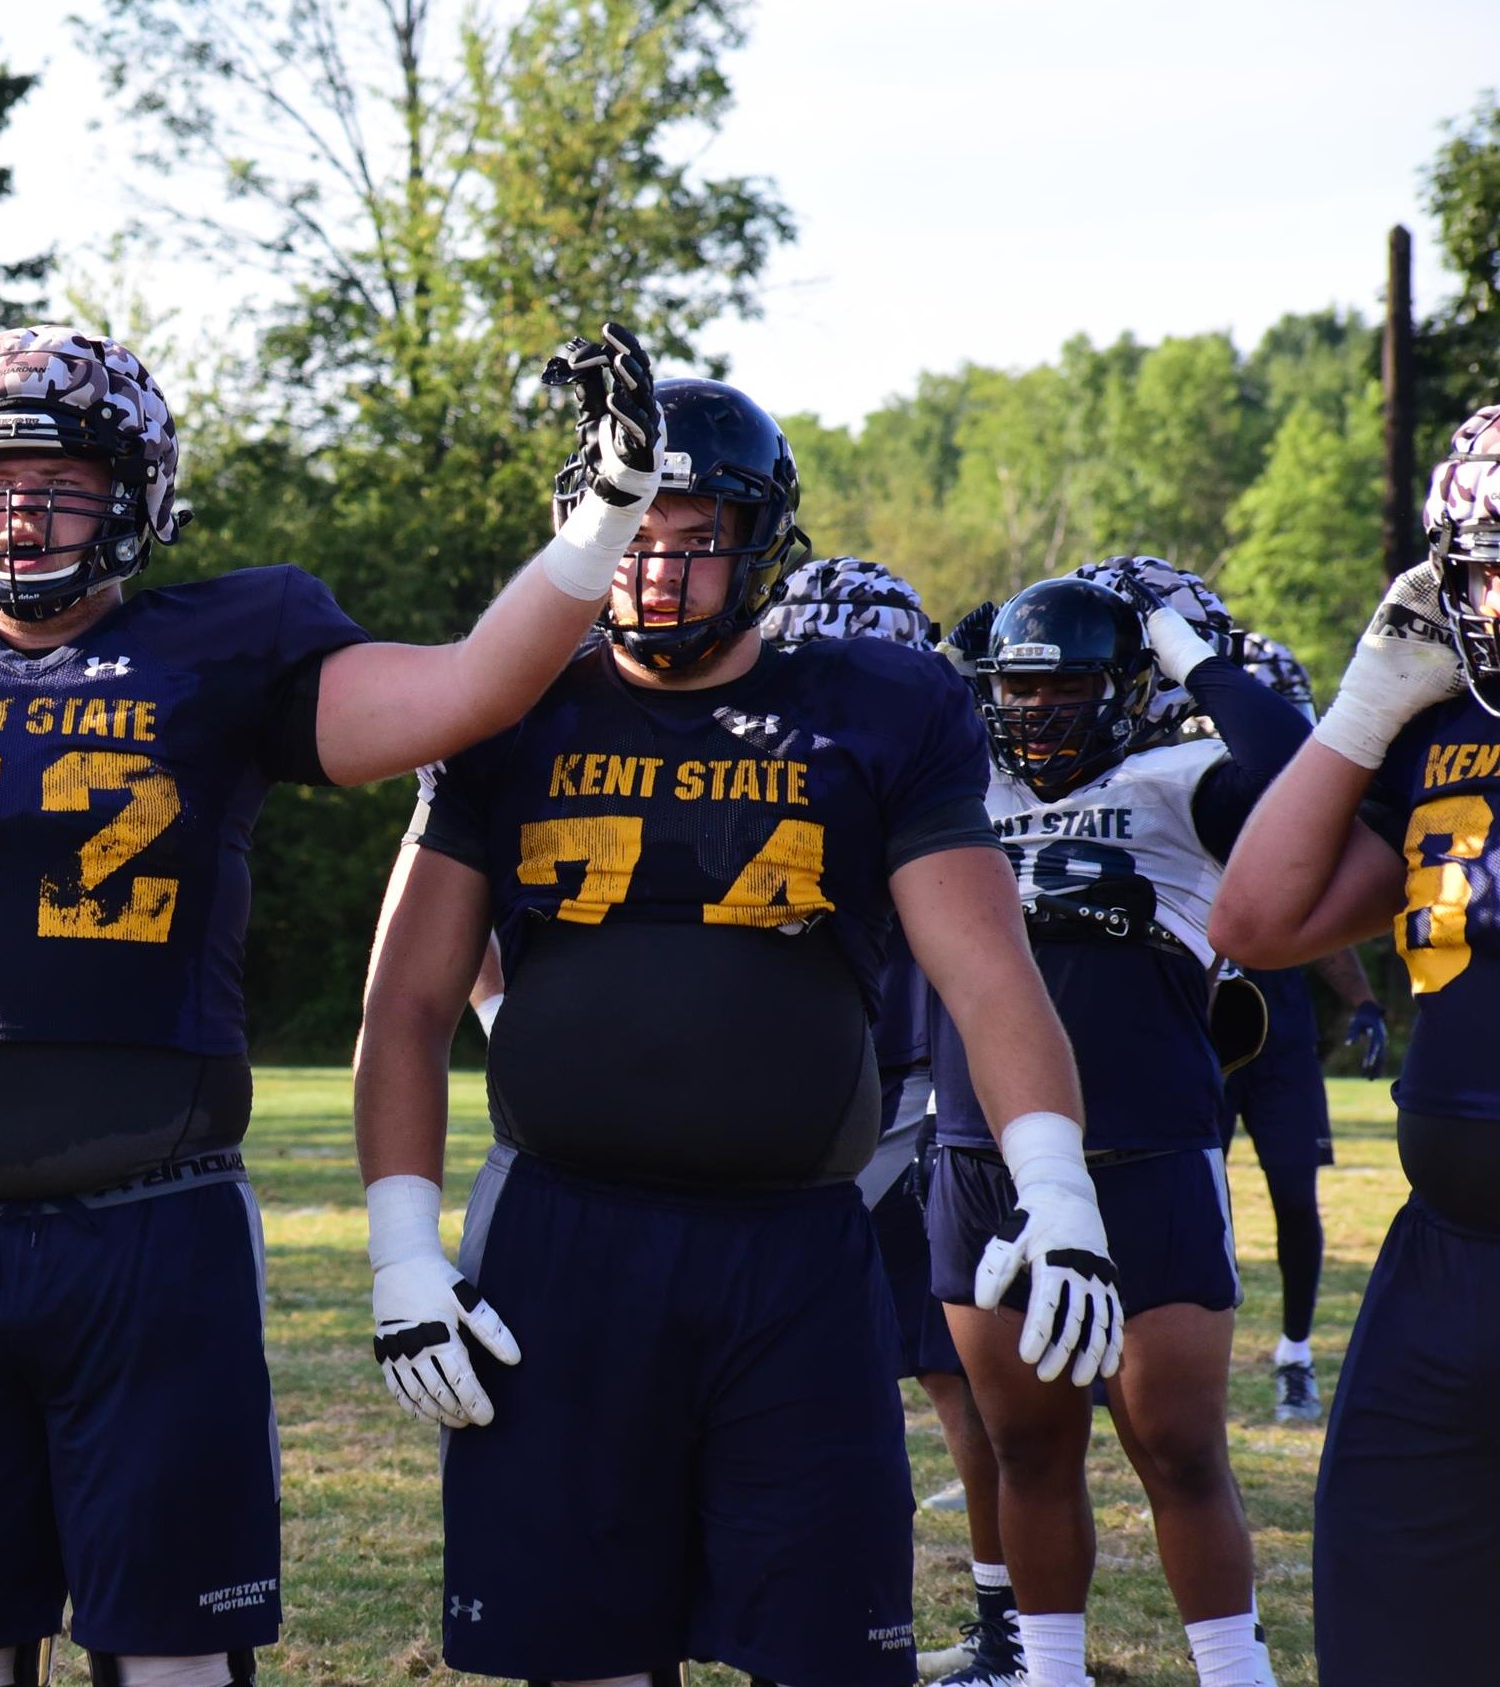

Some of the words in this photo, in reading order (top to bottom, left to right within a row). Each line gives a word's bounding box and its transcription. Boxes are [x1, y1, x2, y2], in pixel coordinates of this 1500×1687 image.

[26, 697, 156, 742] STATE
[550, 753, 664, 798] KENT
[674, 759, 809, 806] STATE
[1424, 743, 1500, 790] KEN
[1041, 808, 1133, 840] STATE
[517, 814, 836, 929] 74
[212, 1594, 265, 1614] FOOTBALL
